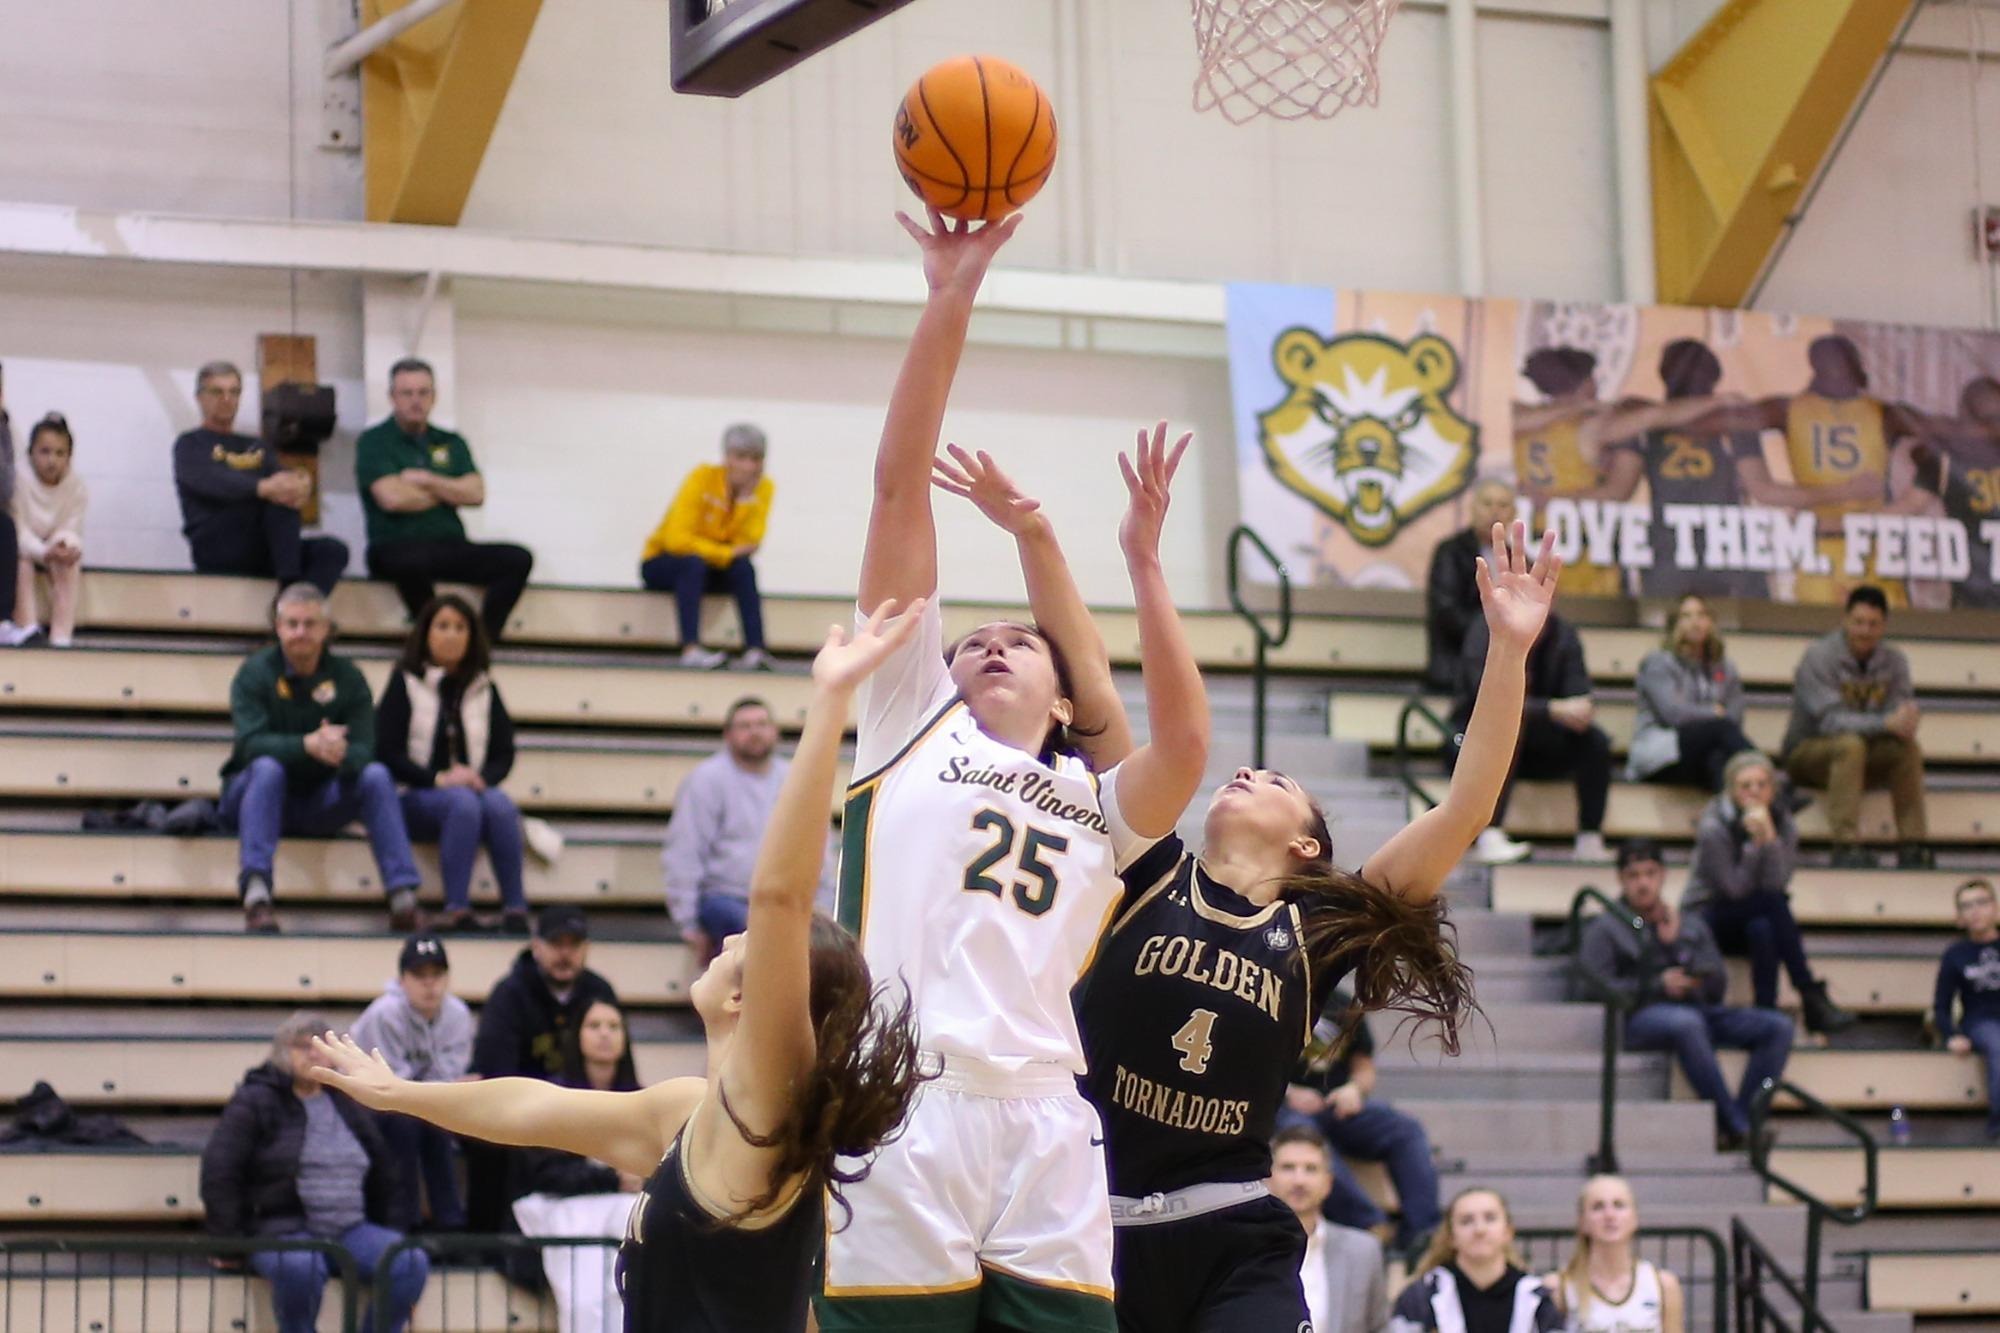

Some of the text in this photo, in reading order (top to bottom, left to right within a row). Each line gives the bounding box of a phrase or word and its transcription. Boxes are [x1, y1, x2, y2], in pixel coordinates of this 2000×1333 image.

[1812, 422, 1863, 473] 15
[1513, 496, 1654, 568] LOVE
[1663, 503, 1831, 576] THEM.
[1842, 512, 1971, 582] FEED
[938, 756, 1109, 835] Saint Vincen
[961, 806, 1072, 920] 25
[1134, 934, 1284, 1022] GOLDEN
[1171, 1008, 1219, 1075] 4
[1112, 1064, 1250, 1135] TORNADOES
